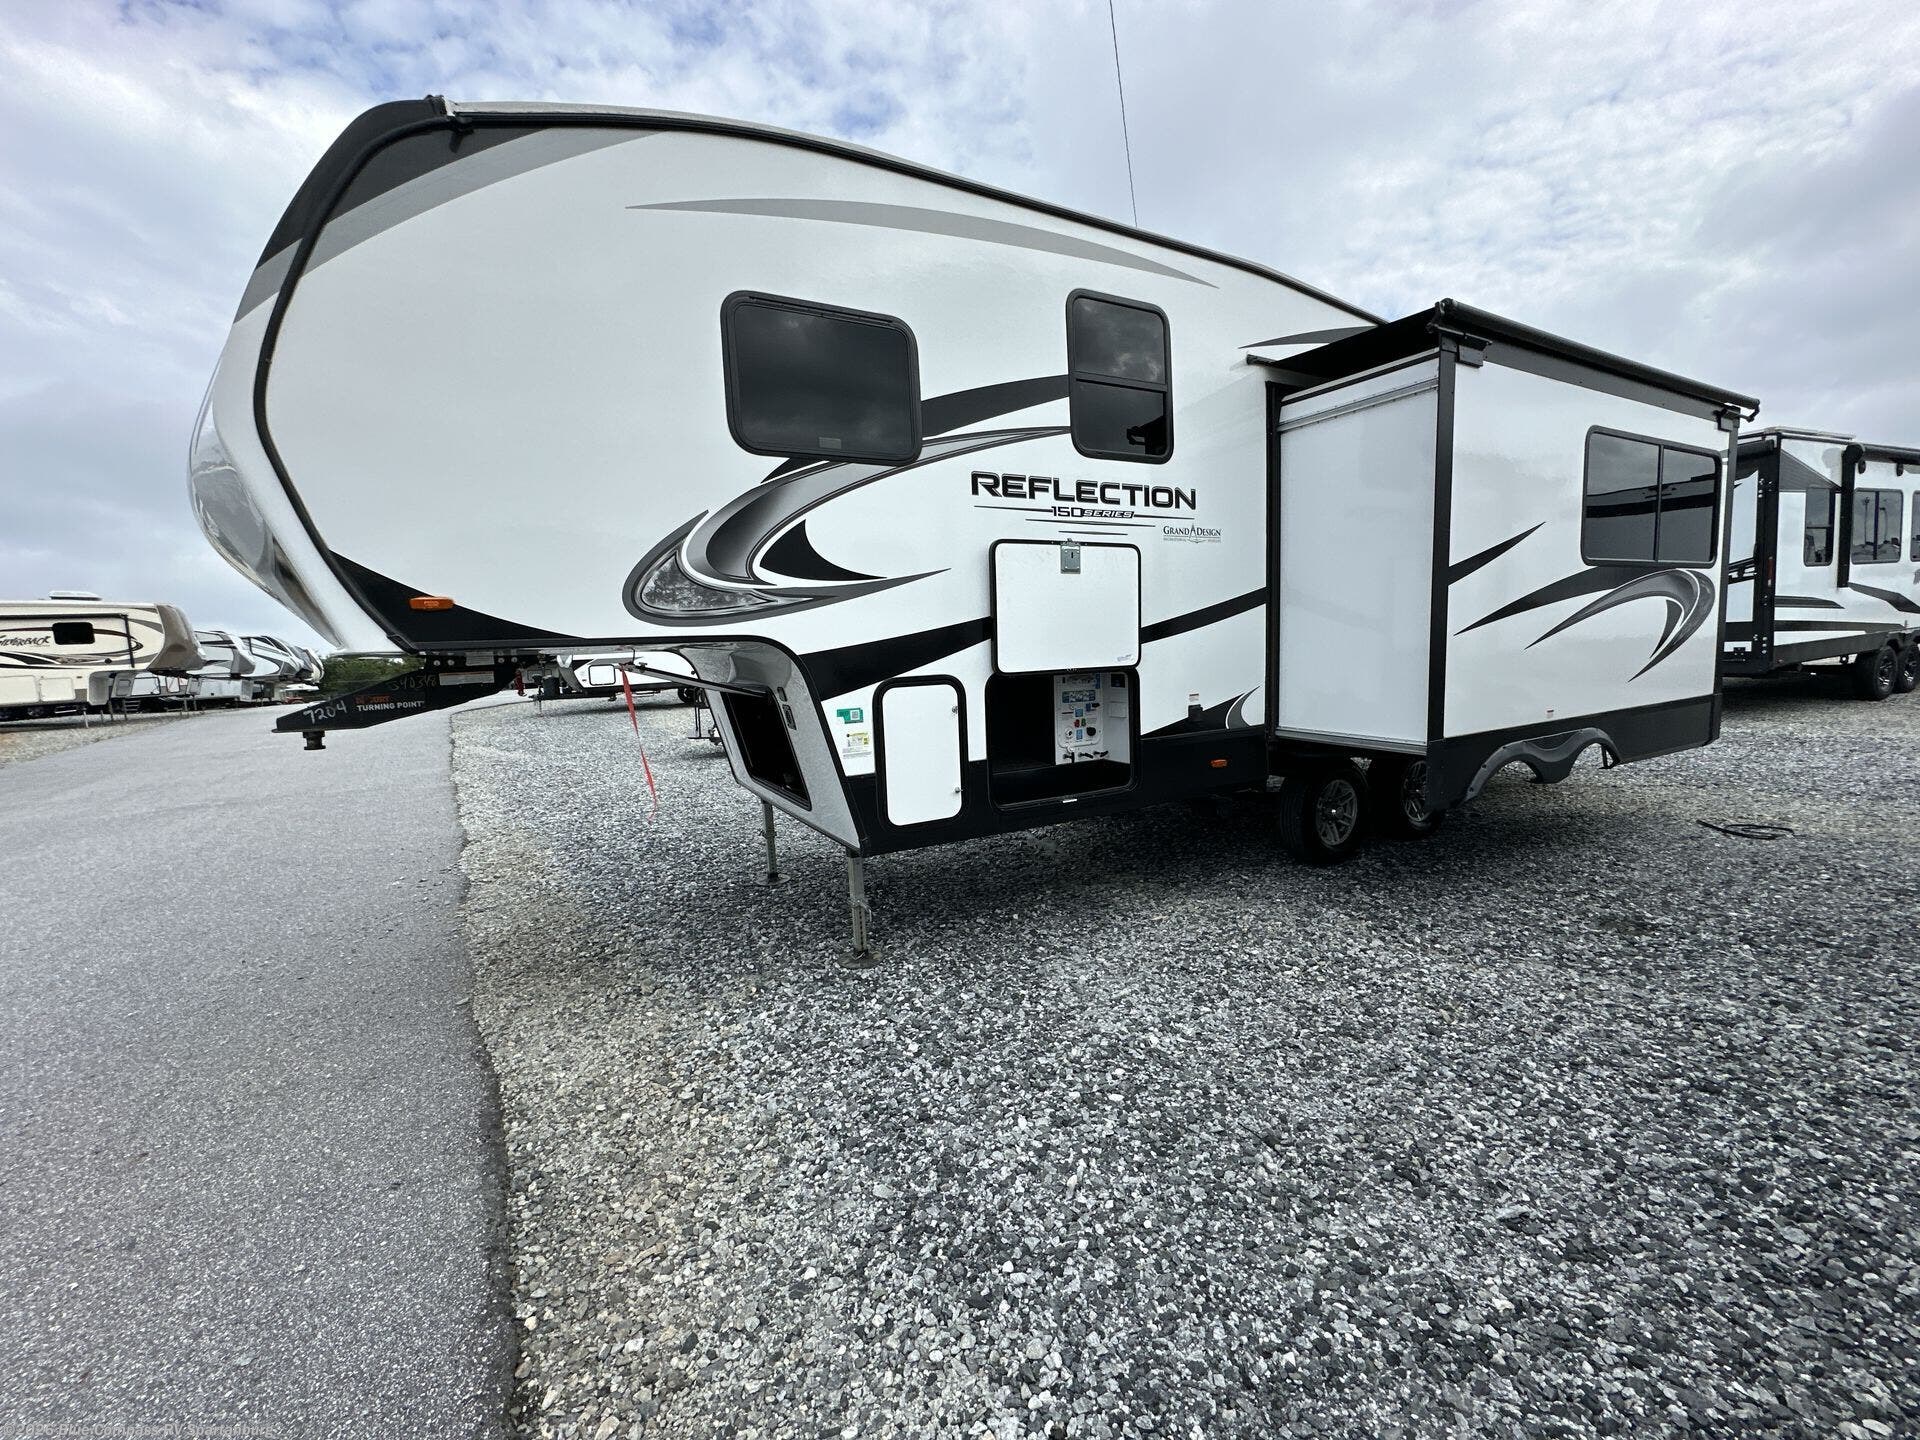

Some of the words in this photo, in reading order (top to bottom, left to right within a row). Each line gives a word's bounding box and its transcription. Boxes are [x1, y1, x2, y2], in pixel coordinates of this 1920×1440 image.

[970, 470, 1197, 511] REFLECTION
[1051, 506, 1083, 517] 150
[1083, 508, 1134, 518] SERIES
[1163, 525, 1190, 536] GRAND
[1196, 527, 1221, 537] DESIGN
[302, 700, 348, 724] 7204
[356, 702, 396, 712] TURNING
